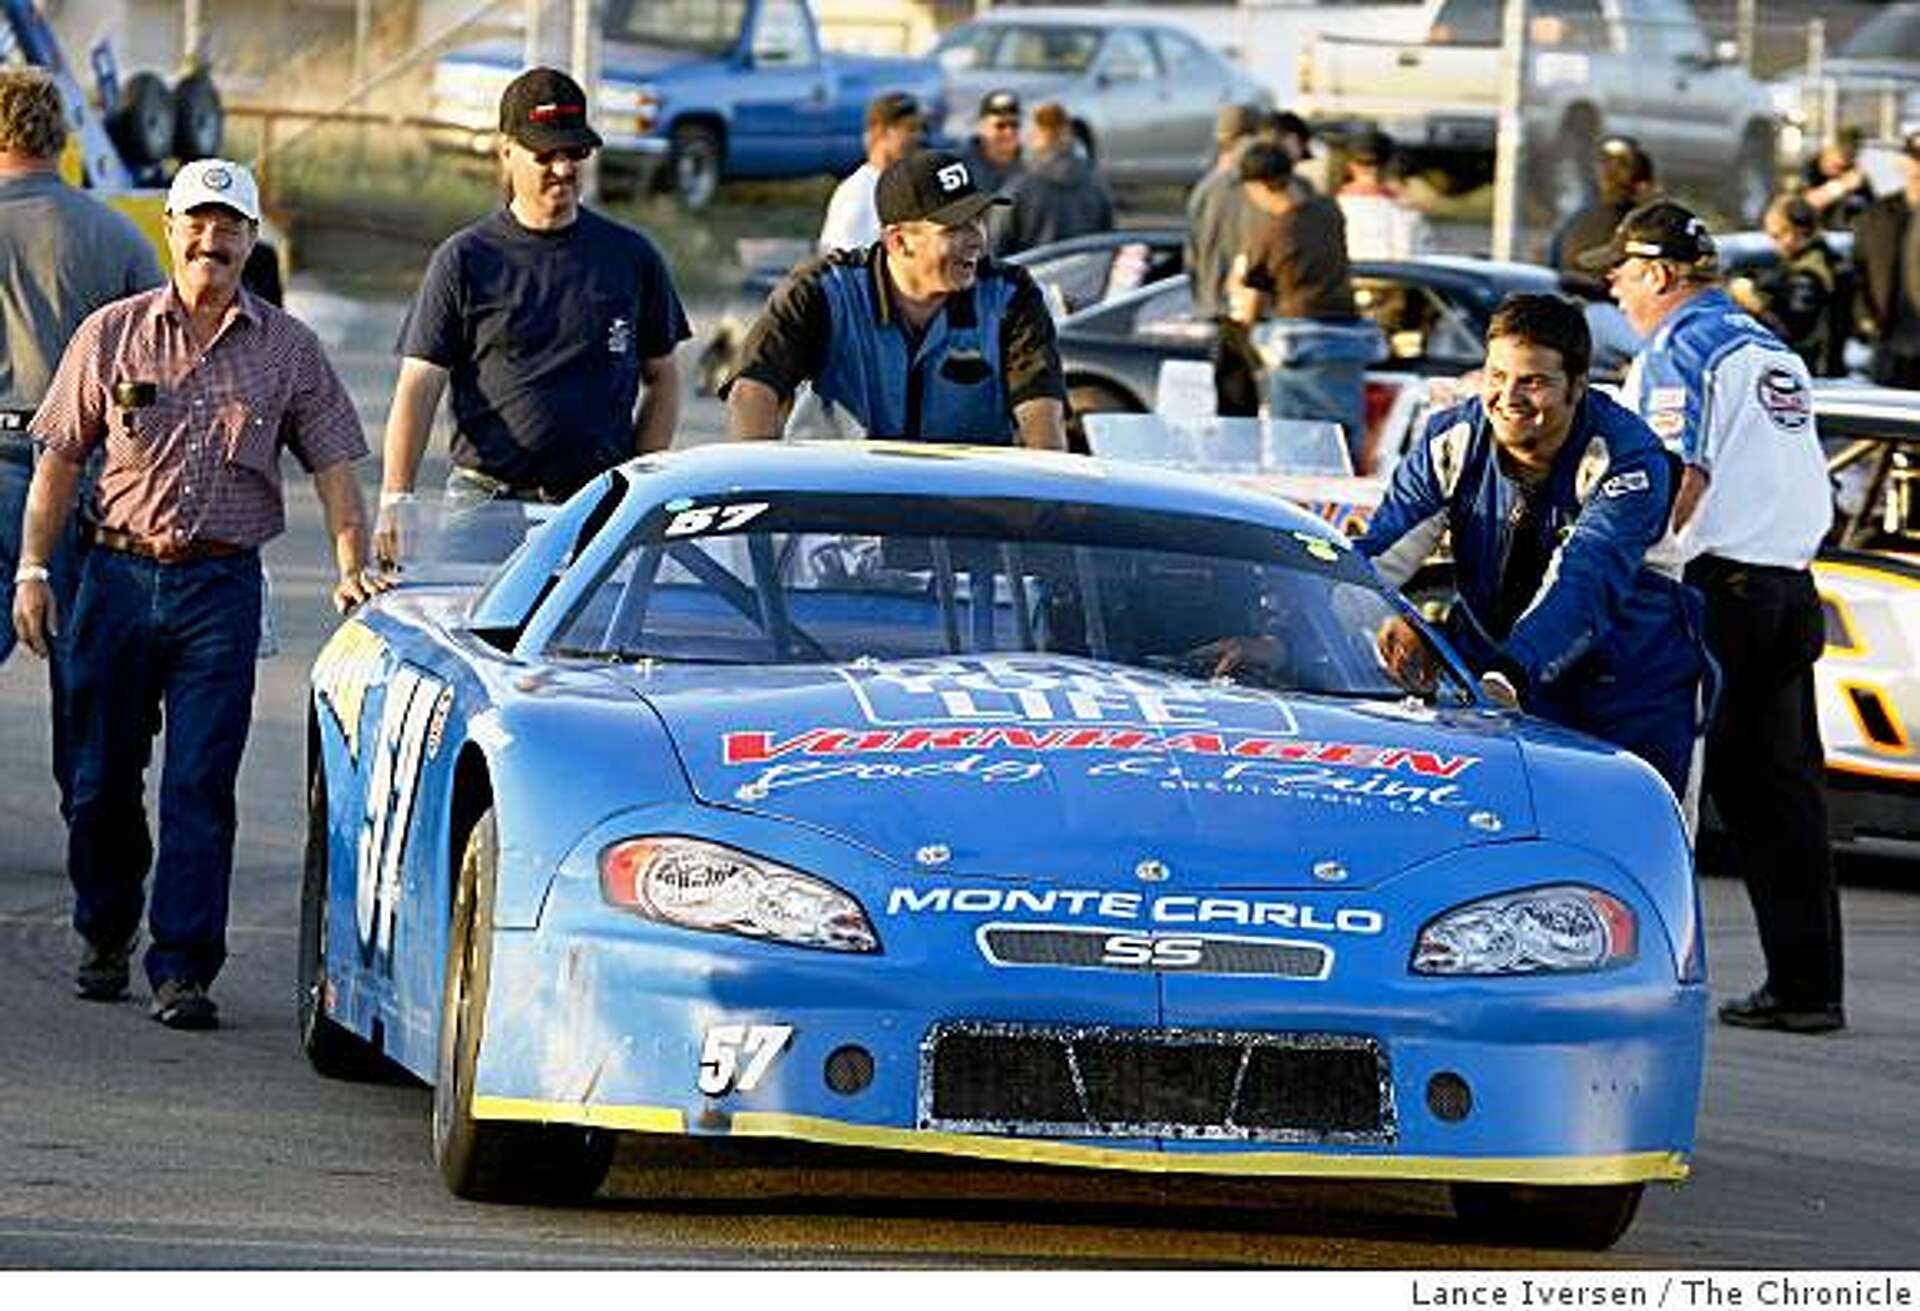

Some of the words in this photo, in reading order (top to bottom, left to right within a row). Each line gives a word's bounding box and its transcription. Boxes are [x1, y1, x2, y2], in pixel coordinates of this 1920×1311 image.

[936, 162, 969, 192] 57
[664, 502, 769, 536] 57
[939, 689, 1219, 727] LIFE
[885, 887, 1143, 919] MONTE
[1151, 895, 1384, 935] CARLO
[1102, 935, 1204, 967] SS
[698, 1025, 795, 1095] 57
